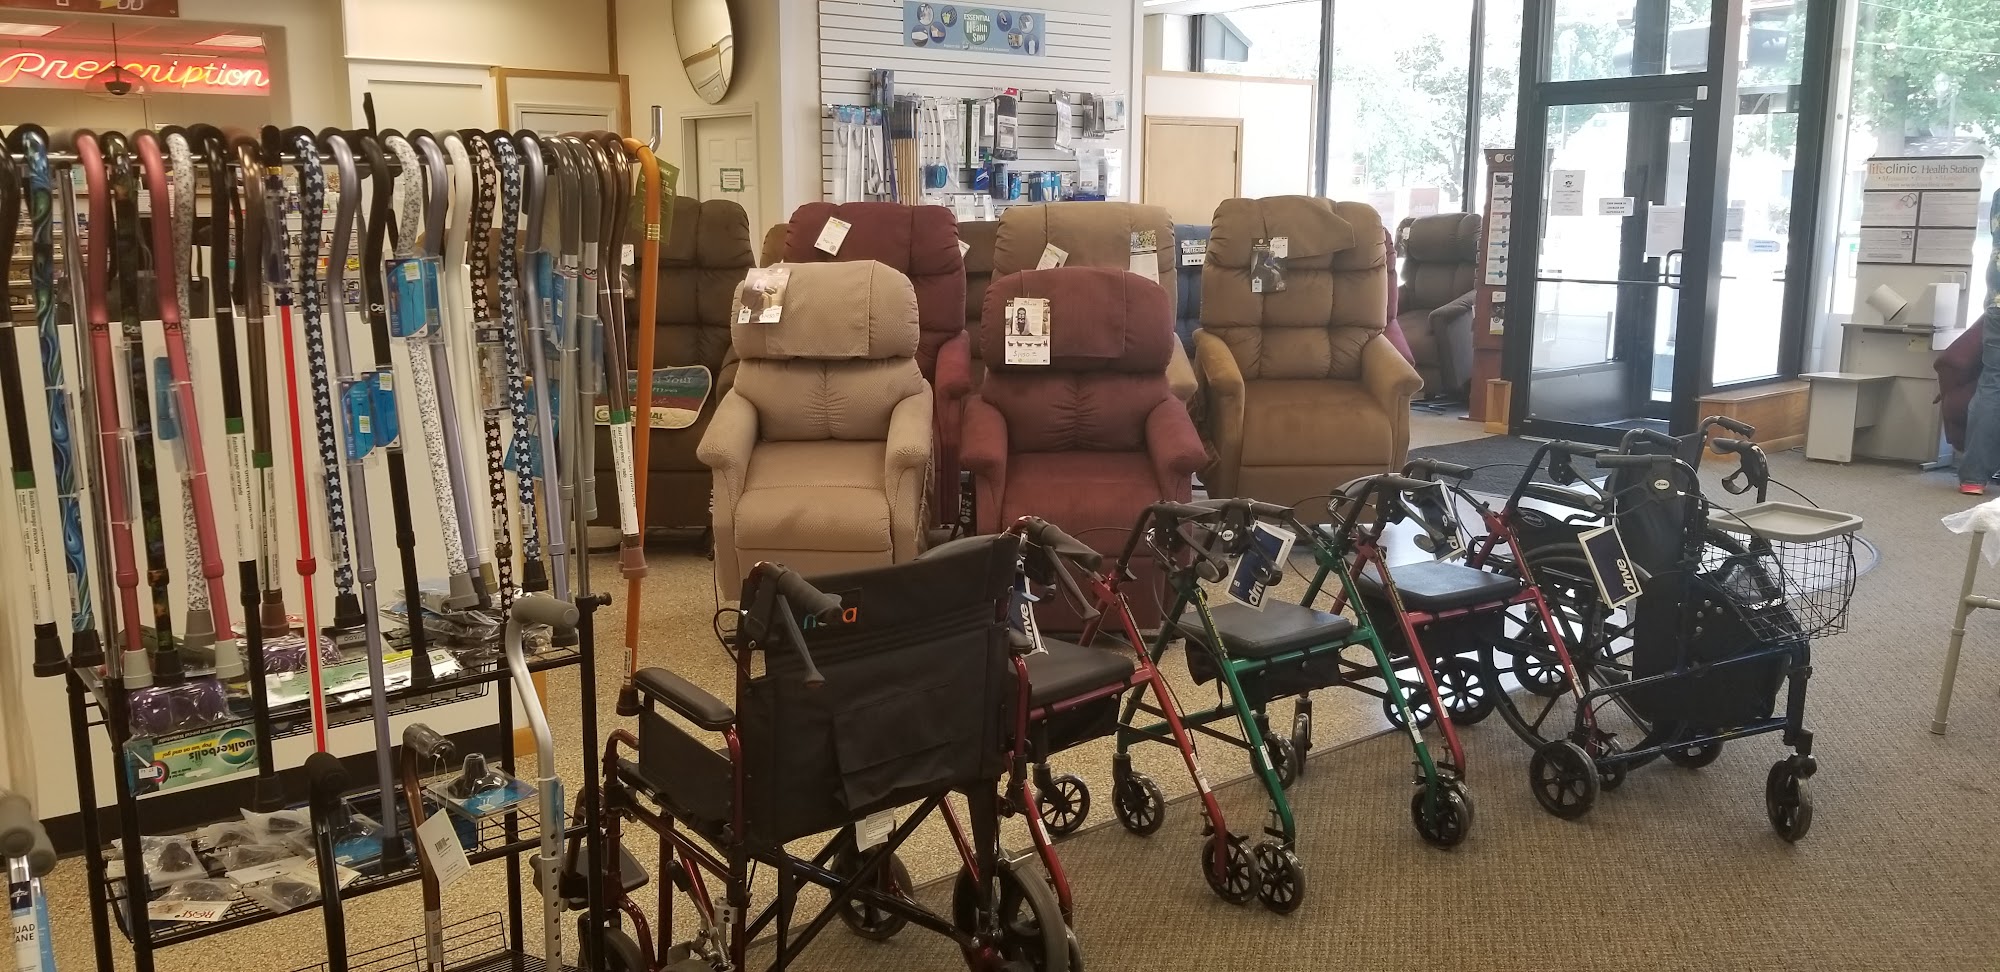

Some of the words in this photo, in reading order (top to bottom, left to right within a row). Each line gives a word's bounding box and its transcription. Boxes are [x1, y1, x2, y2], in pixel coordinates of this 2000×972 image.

[963, 13, 991, 22] ESSENTIAL
[966, 21, 988, 33] Health
[972, 32, 986, 42] Spot
[1869, 163, 1917, 174] lifeclinic
[1921, 164, 1949, 174] Health
[1950, 164, 1978, 174] Station
[1616, 558, 1637, 594] drive
[804, 607, 858, 629] na
[188, 738, 256, 760] walkerballs
[13, 923, 36, 937] UAD
[14, 932, 35, 944] ANE
